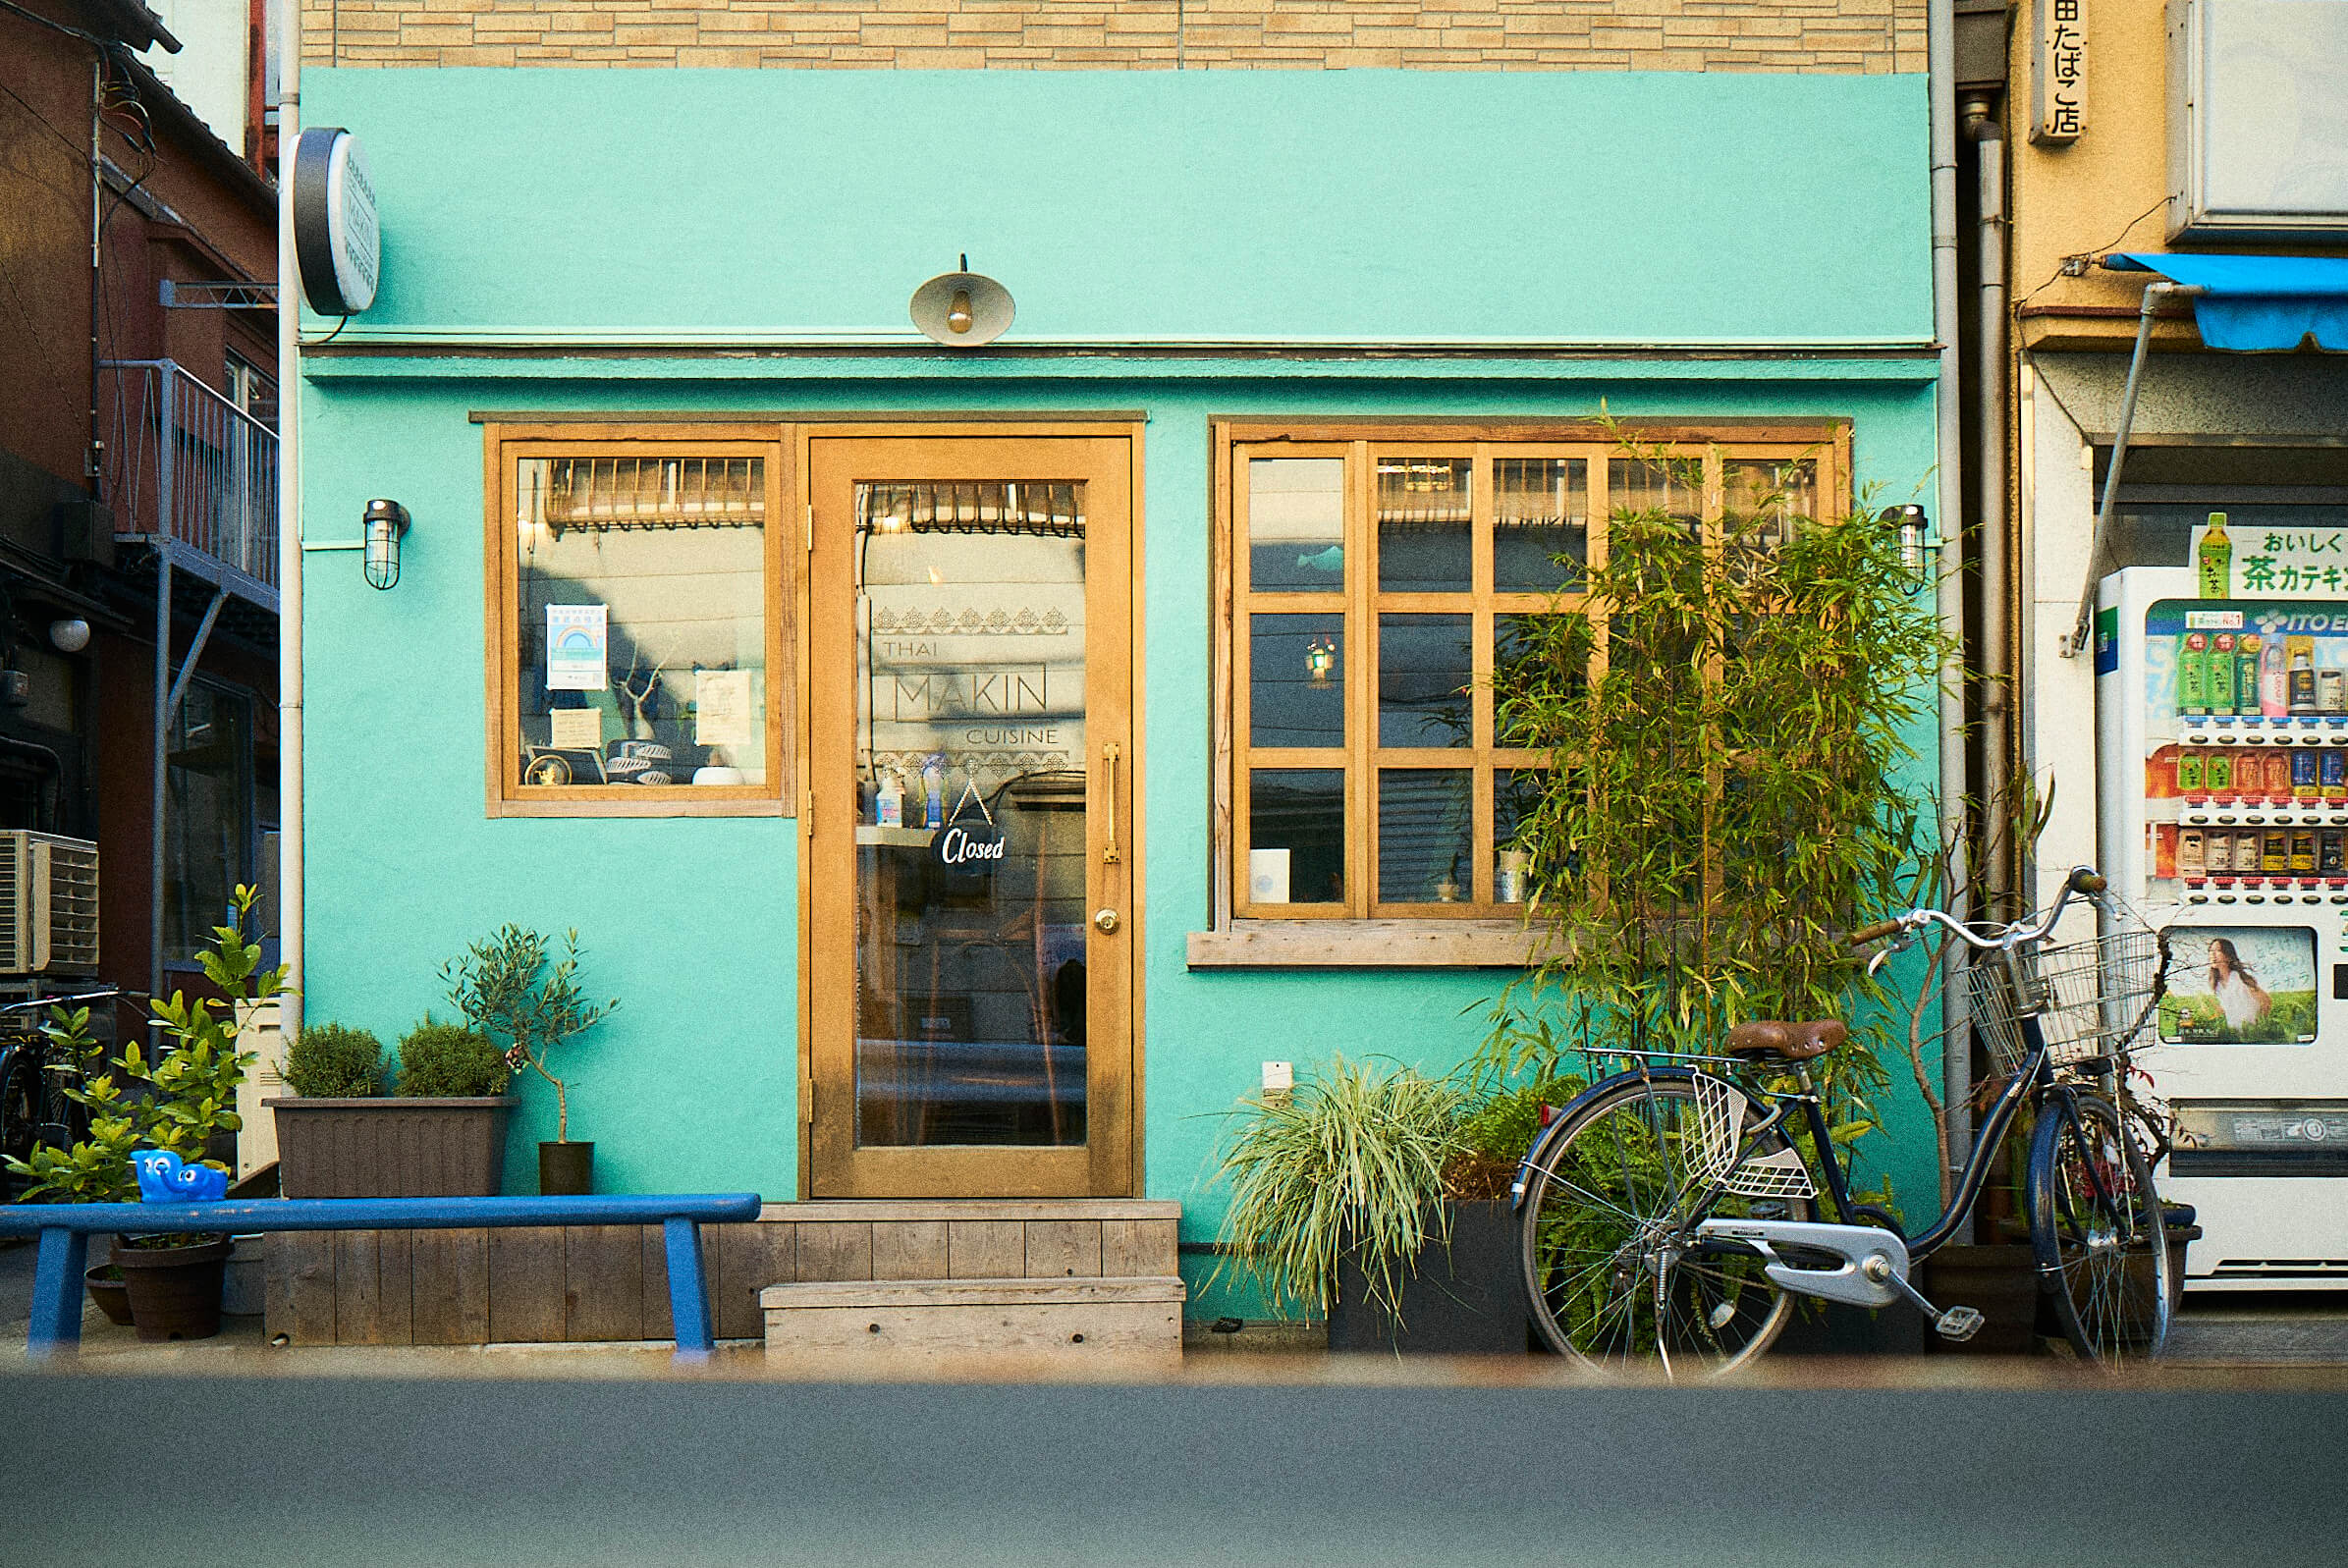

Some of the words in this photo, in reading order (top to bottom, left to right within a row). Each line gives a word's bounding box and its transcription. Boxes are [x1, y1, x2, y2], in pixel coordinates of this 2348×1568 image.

[2051, 0, 2081, 134] 田たばこ店
[2264, 532, 2342, 553] おいしく
[2242, 555, 2348, 592] 茶カテキ
[2287, 614, 2329, 631] ITO
[2331, 614, 2348, 631] E
[884, 642, 938, 657] THAI
[895, 669, 1047, 717] MAKIN
[966, 730, 1060, 745] CUISINE
[942, 827, 1006, 864] Closed
